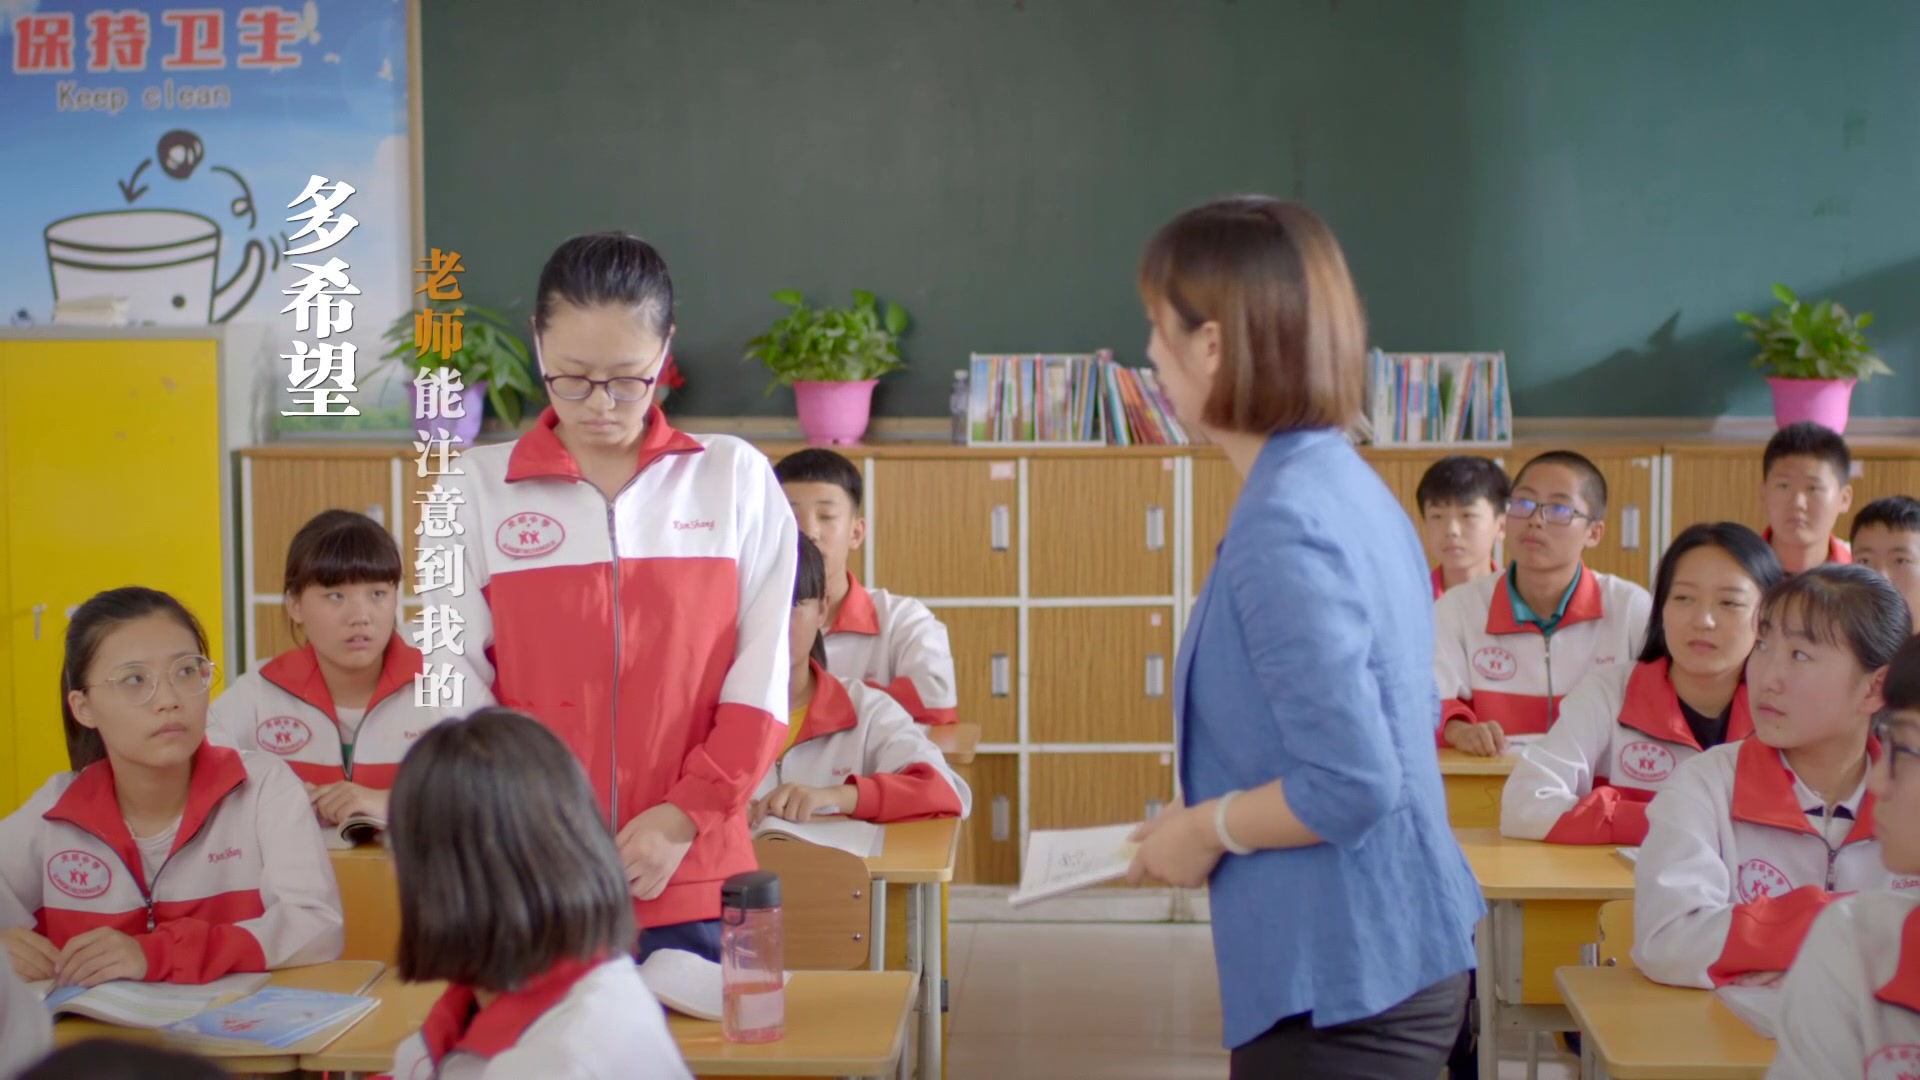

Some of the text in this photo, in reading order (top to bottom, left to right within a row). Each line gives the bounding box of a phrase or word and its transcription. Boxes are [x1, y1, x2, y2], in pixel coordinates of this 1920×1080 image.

[13, 9, 301, 72] 保持卫生
[57, 79, 230, 115] Keep clean
